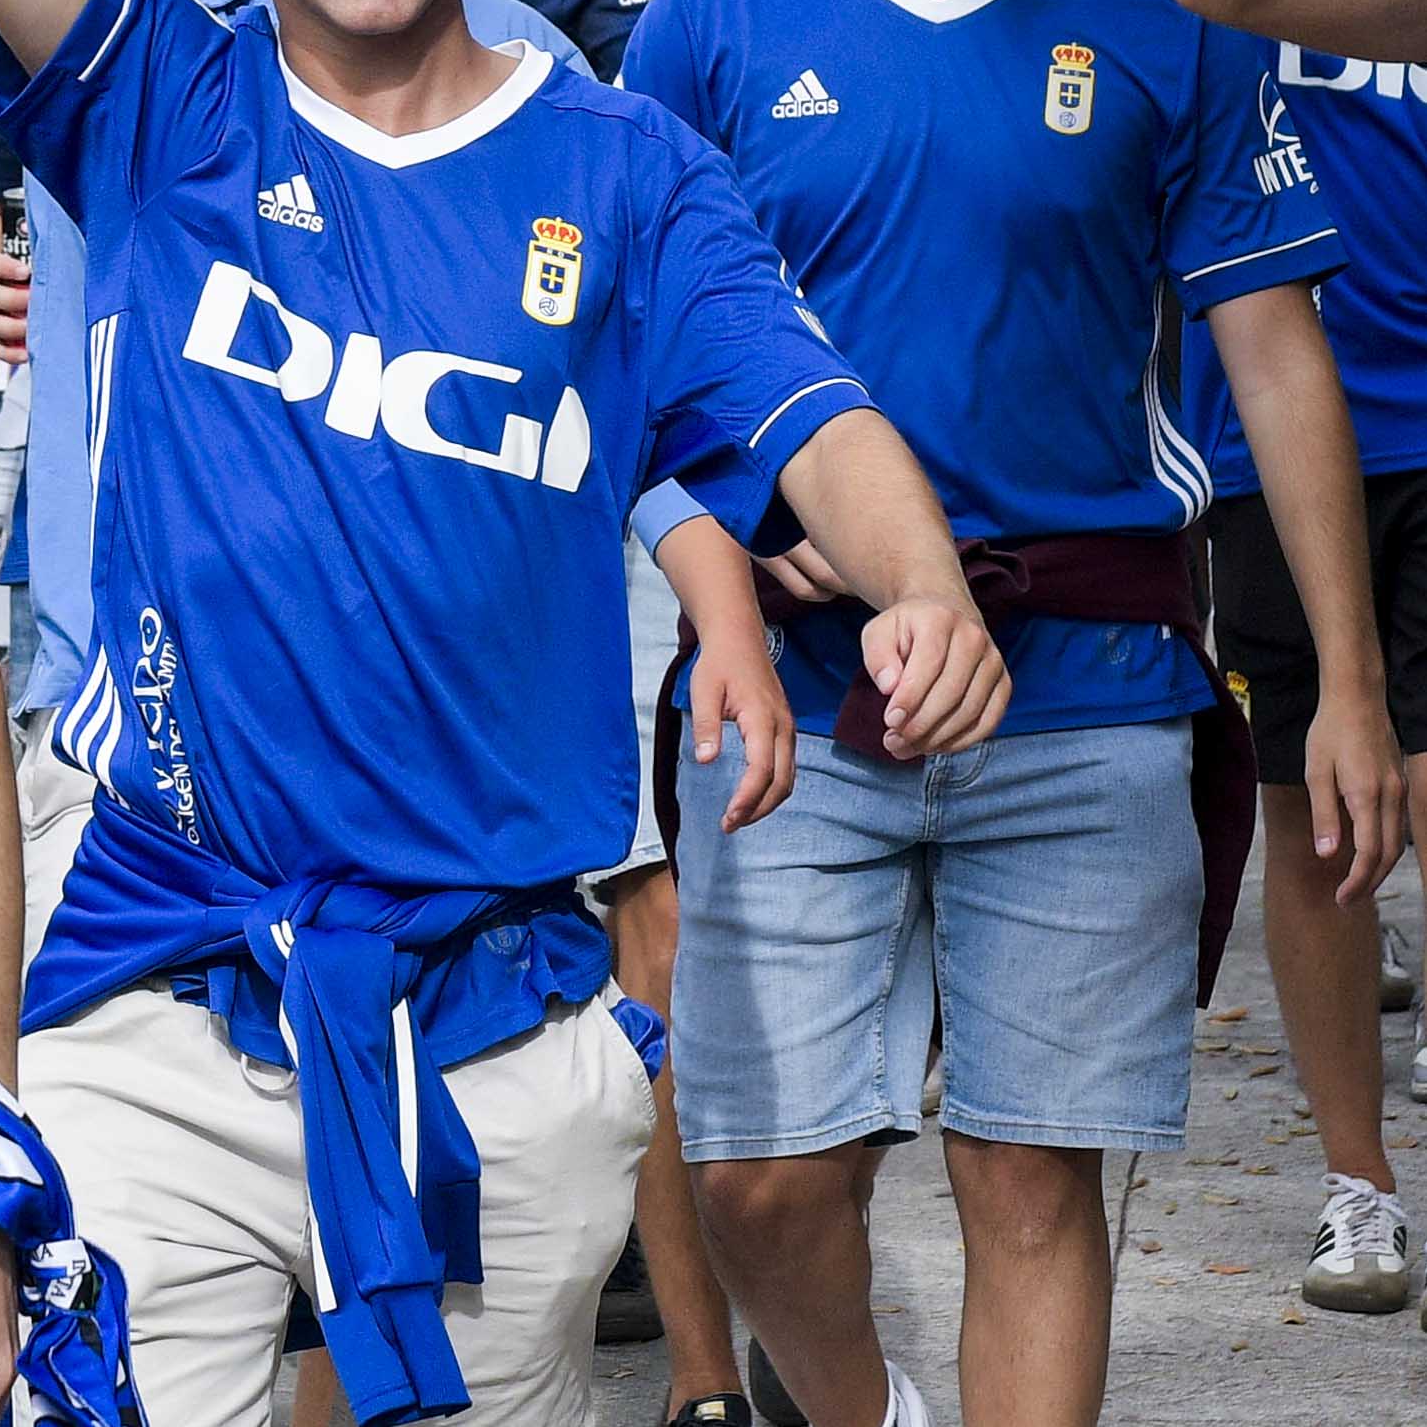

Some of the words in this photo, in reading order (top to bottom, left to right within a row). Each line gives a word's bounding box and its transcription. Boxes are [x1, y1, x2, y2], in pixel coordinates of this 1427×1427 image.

[771, 98, 839, 119] adidas
[1253, 142, 1313, 196] INTE
[181, 260, 592, 493] DIGI
